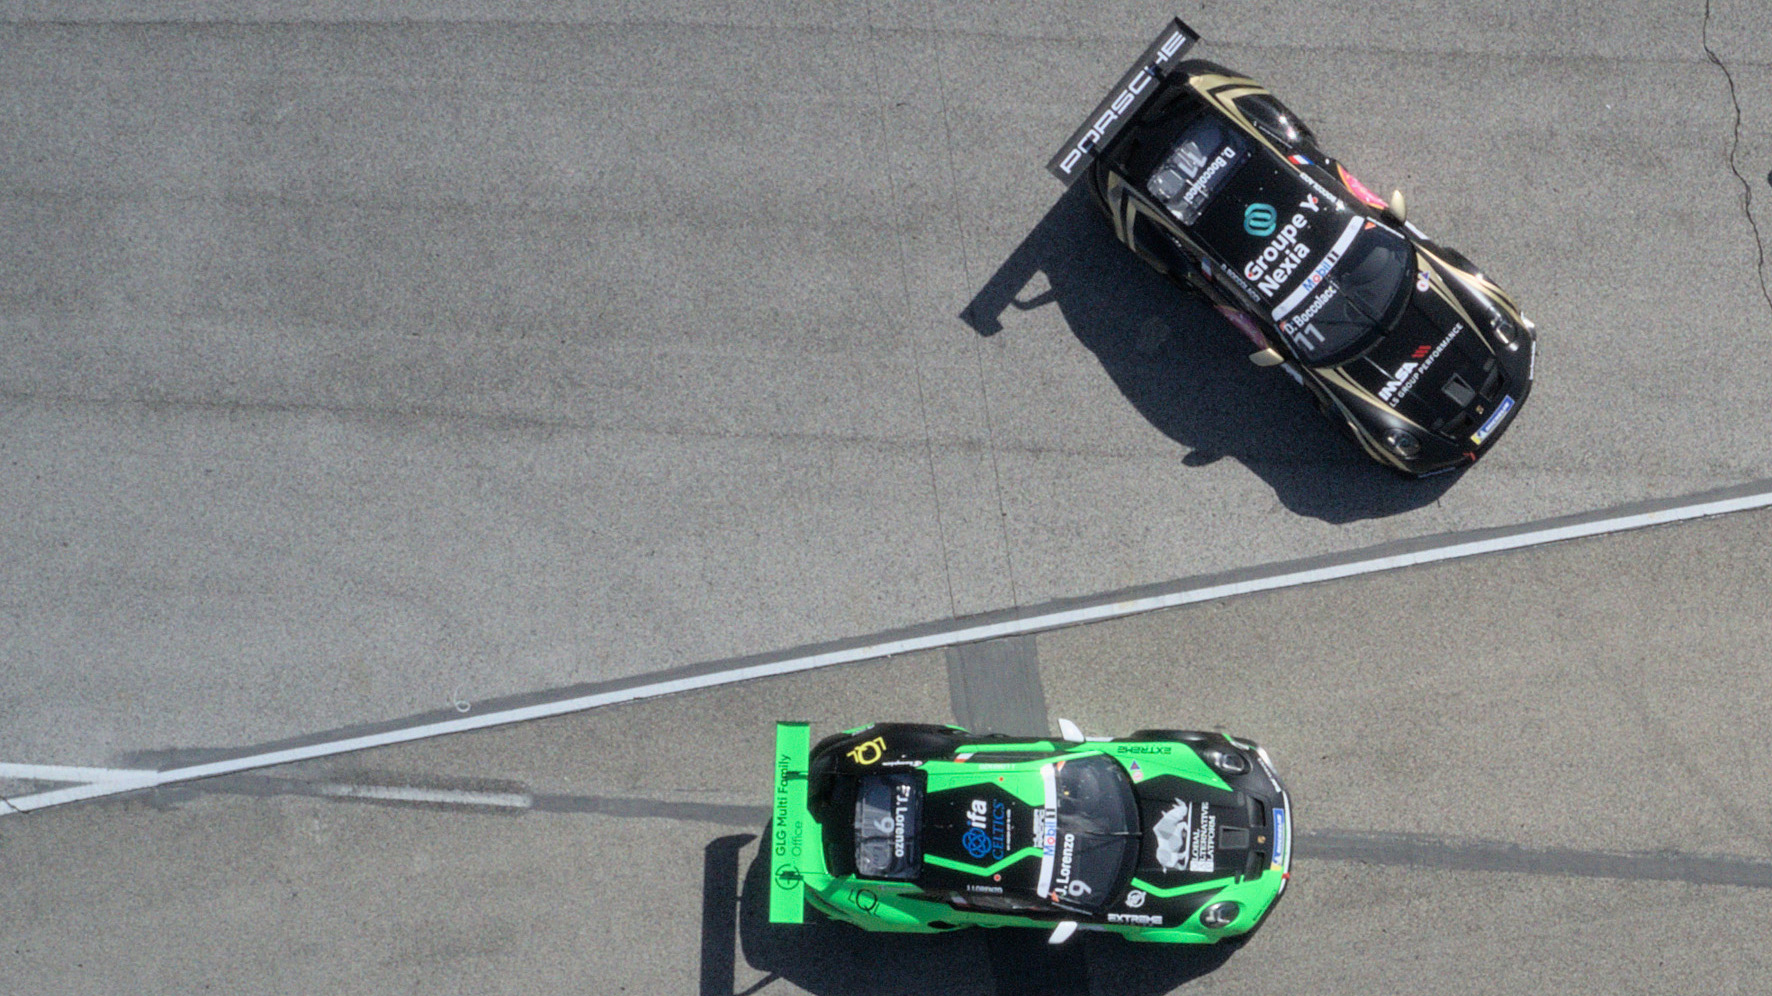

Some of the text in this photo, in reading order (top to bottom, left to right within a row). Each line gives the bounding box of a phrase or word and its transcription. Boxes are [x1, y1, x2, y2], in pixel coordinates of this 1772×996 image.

[1059, 31, 1185, 173] PORSCHE
[1177, 144, 1206, 177] 11
[1183, 146, 1235, 204] D. Boccolacci
[1243, 193, 1319, 285] Groupe Y
[1257, 239, 1310, 296] Nexia
[1301, 259, 1332, 293] Mobil
[1281, 280, 1338, 335] D. Boccolacci
[1292, 322, 1325, 350] 11
[1378, 362, 1418, 400] IMSA
[1388, 322, 1462, 407] LS GROUP PERFORMANCE
[1117, 745, 1171, 754] EXTREME
[776, 754, 791, 855] GLG Multi Family
[966, 799, 987, 828] ifa
[791, 820, 803, 856] Office
[874, 816, 894, 833] 9
[894, 807, 907, 857] Lorenzo
[991, 802, 1005, 860] CELTICS
[1043, 821, 1056, 856] Mobil
[1055, 832, 1074, 895] J. Lorenzo
[1069, 879, 1091, 896] 9
[1107, 912, 1162, 924] EXTREME
